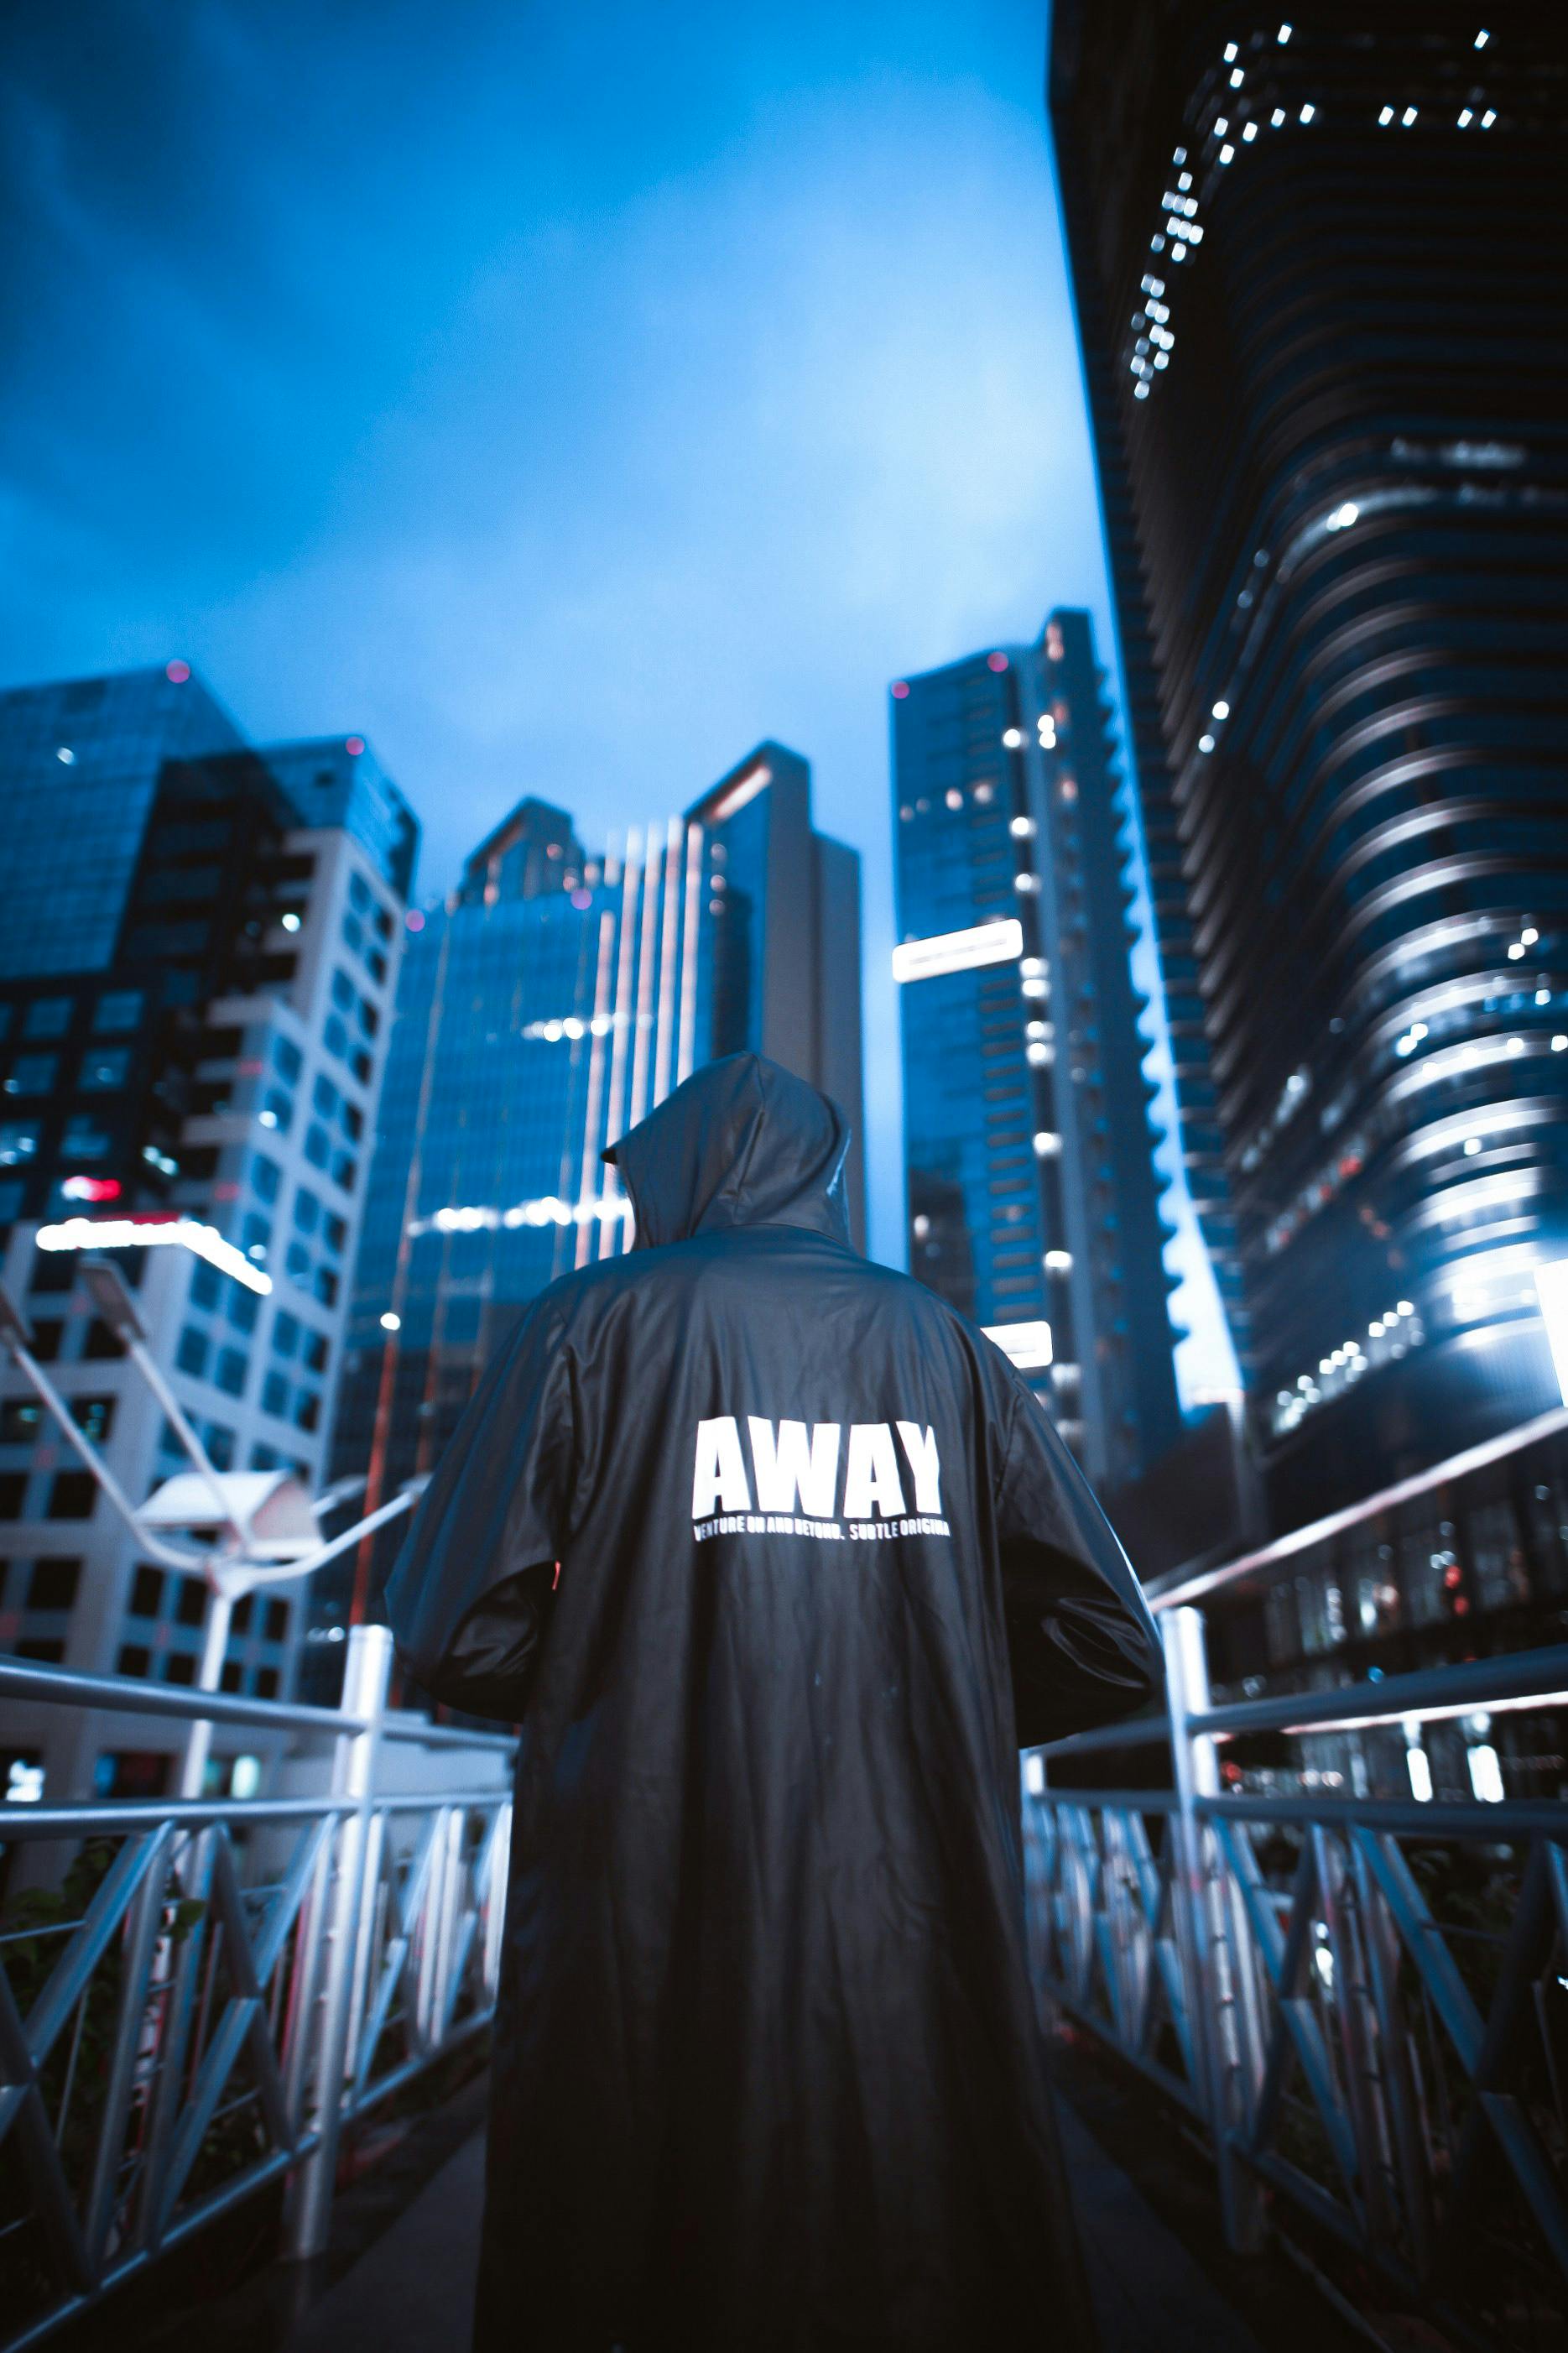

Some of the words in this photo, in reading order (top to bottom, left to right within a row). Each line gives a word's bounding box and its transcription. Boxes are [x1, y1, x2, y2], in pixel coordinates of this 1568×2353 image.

[692, 1416, 941, 1520] AWAY
[693, 1516, 745, 1542] VENTURE
[747, 1516, 765, 1533] ON
[767, 1516, 794, 1534] AND
[849, 1521, 898, 1541] SUBTLE
